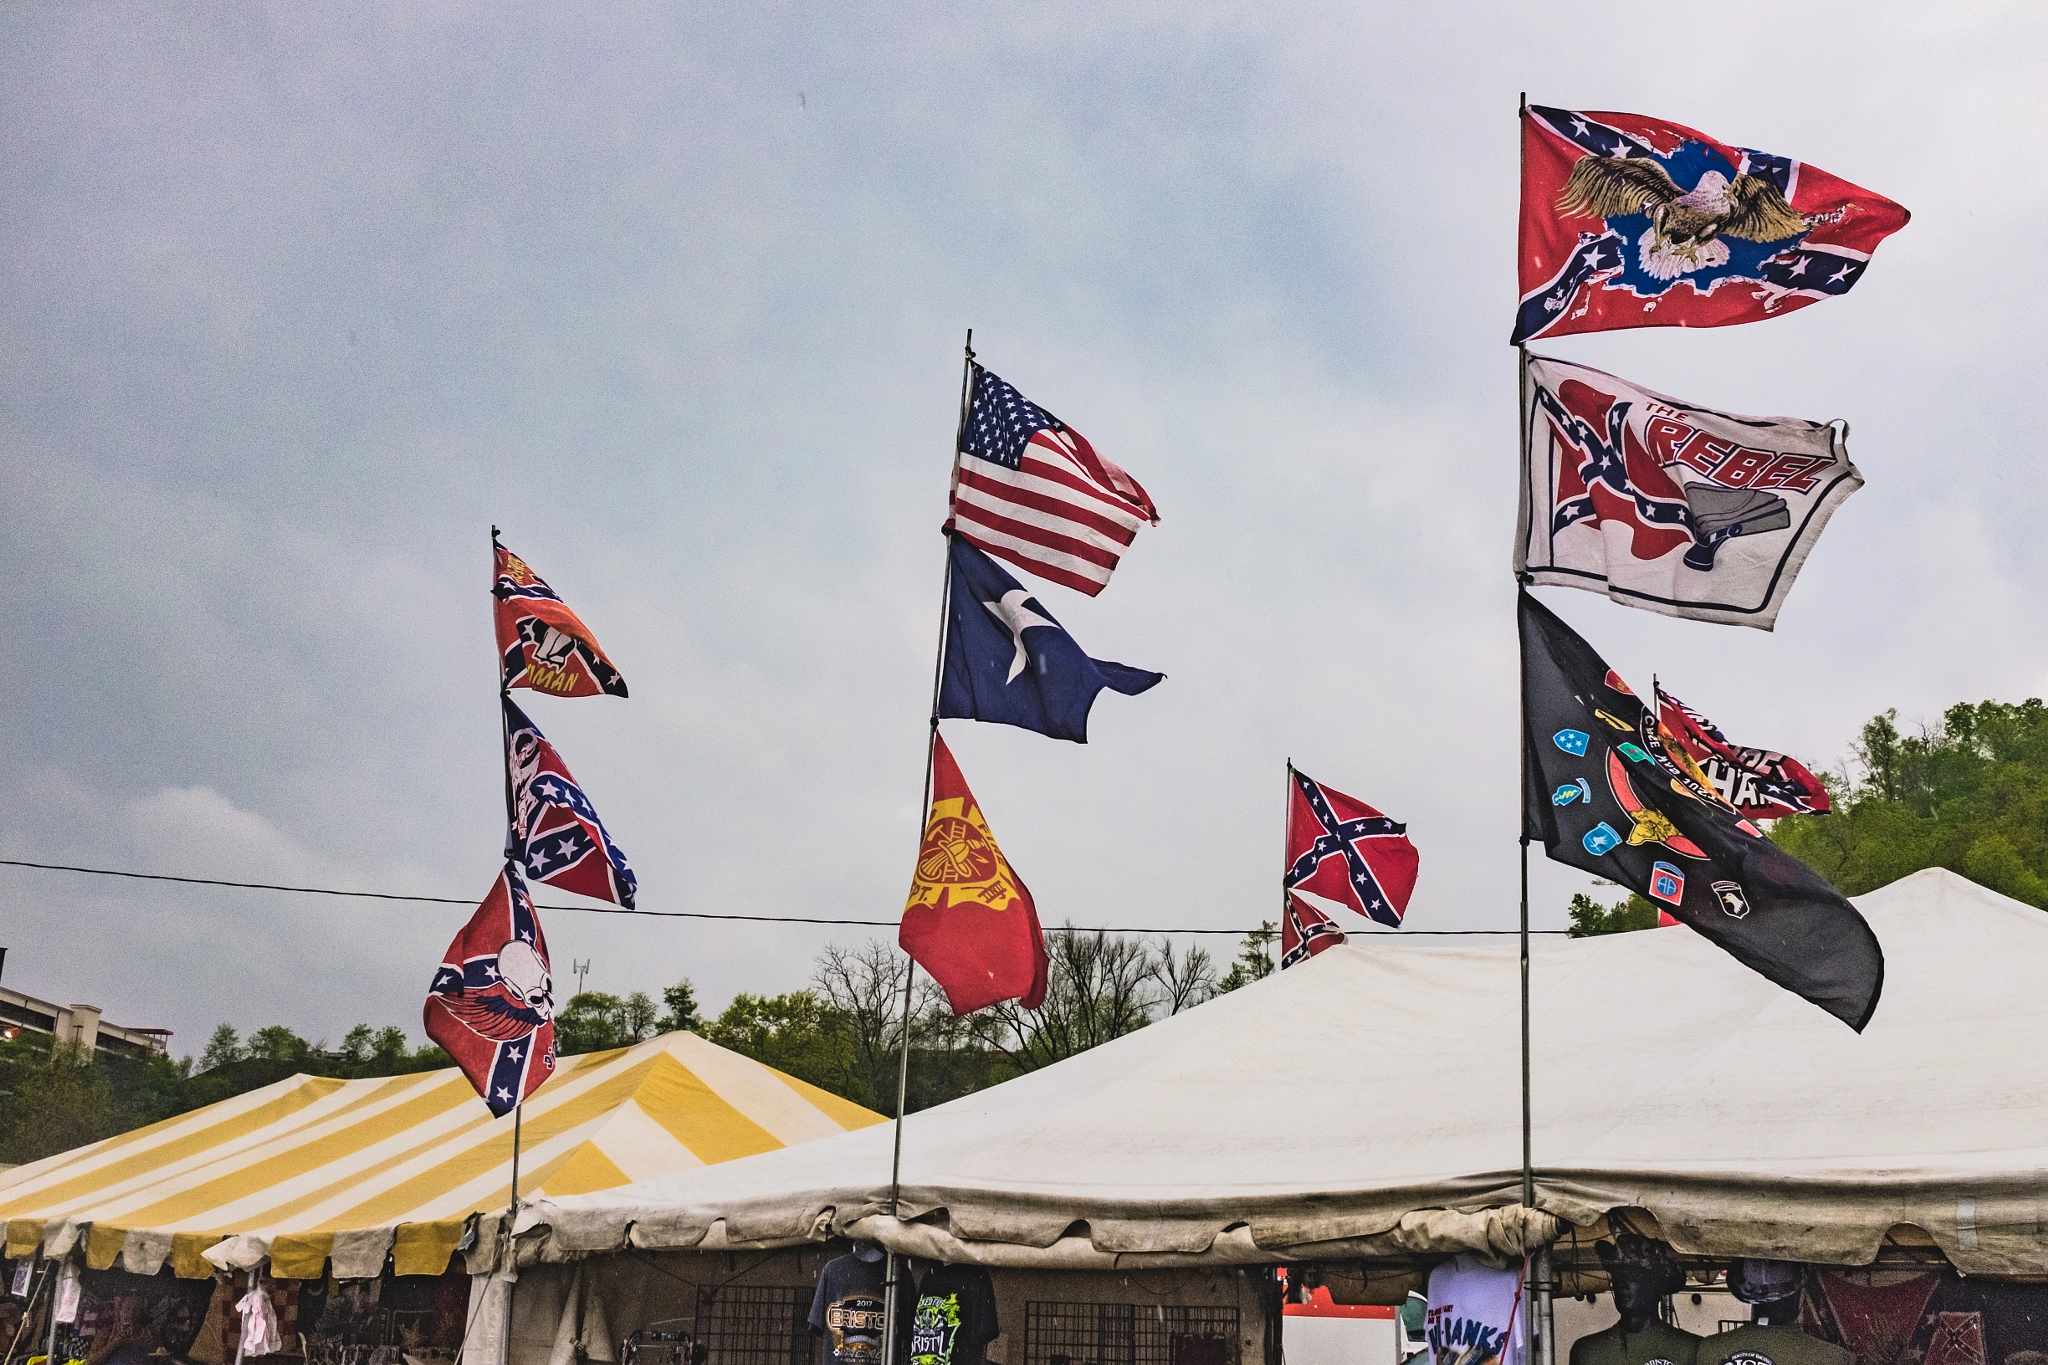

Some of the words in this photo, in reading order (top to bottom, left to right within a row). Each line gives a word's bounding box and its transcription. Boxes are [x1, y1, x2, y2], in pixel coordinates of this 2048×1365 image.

[1646, 401, 1690, 422] THE
[1645, 414, 1837, 495] REBEL
[830, 1308, 885, 1330] BRISTO
